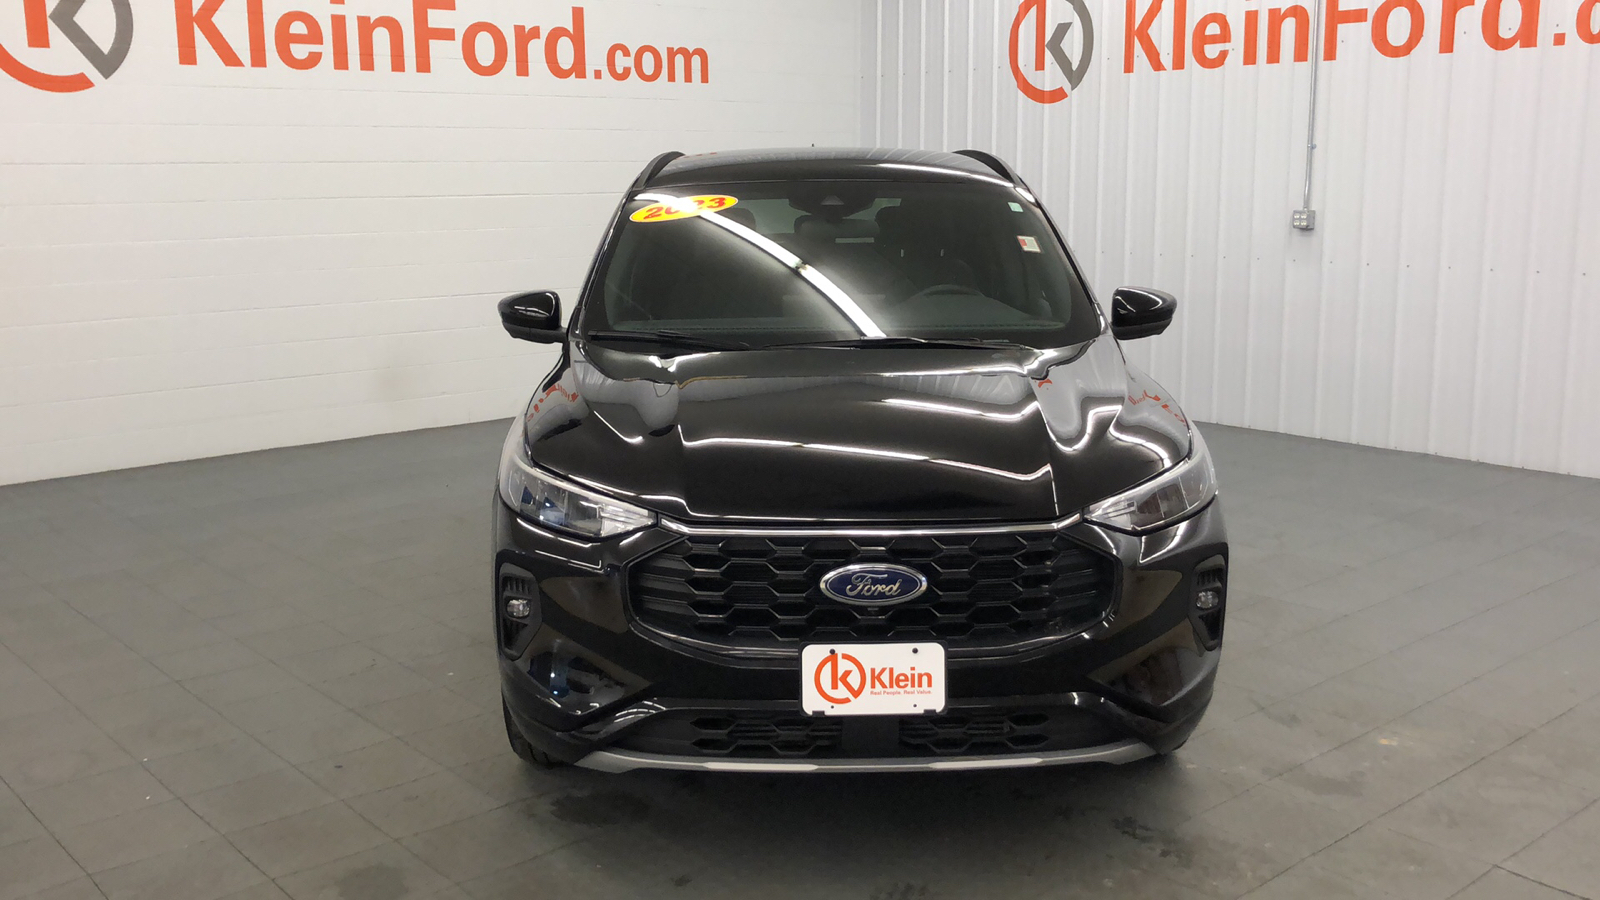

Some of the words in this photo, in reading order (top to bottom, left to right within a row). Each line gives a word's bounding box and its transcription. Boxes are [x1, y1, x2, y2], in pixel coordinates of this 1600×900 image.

[174, 0, 709, 84] KleinFord.com
[845, 573, 902, 596] Ford
[870, 667, 933, 689] Klein
